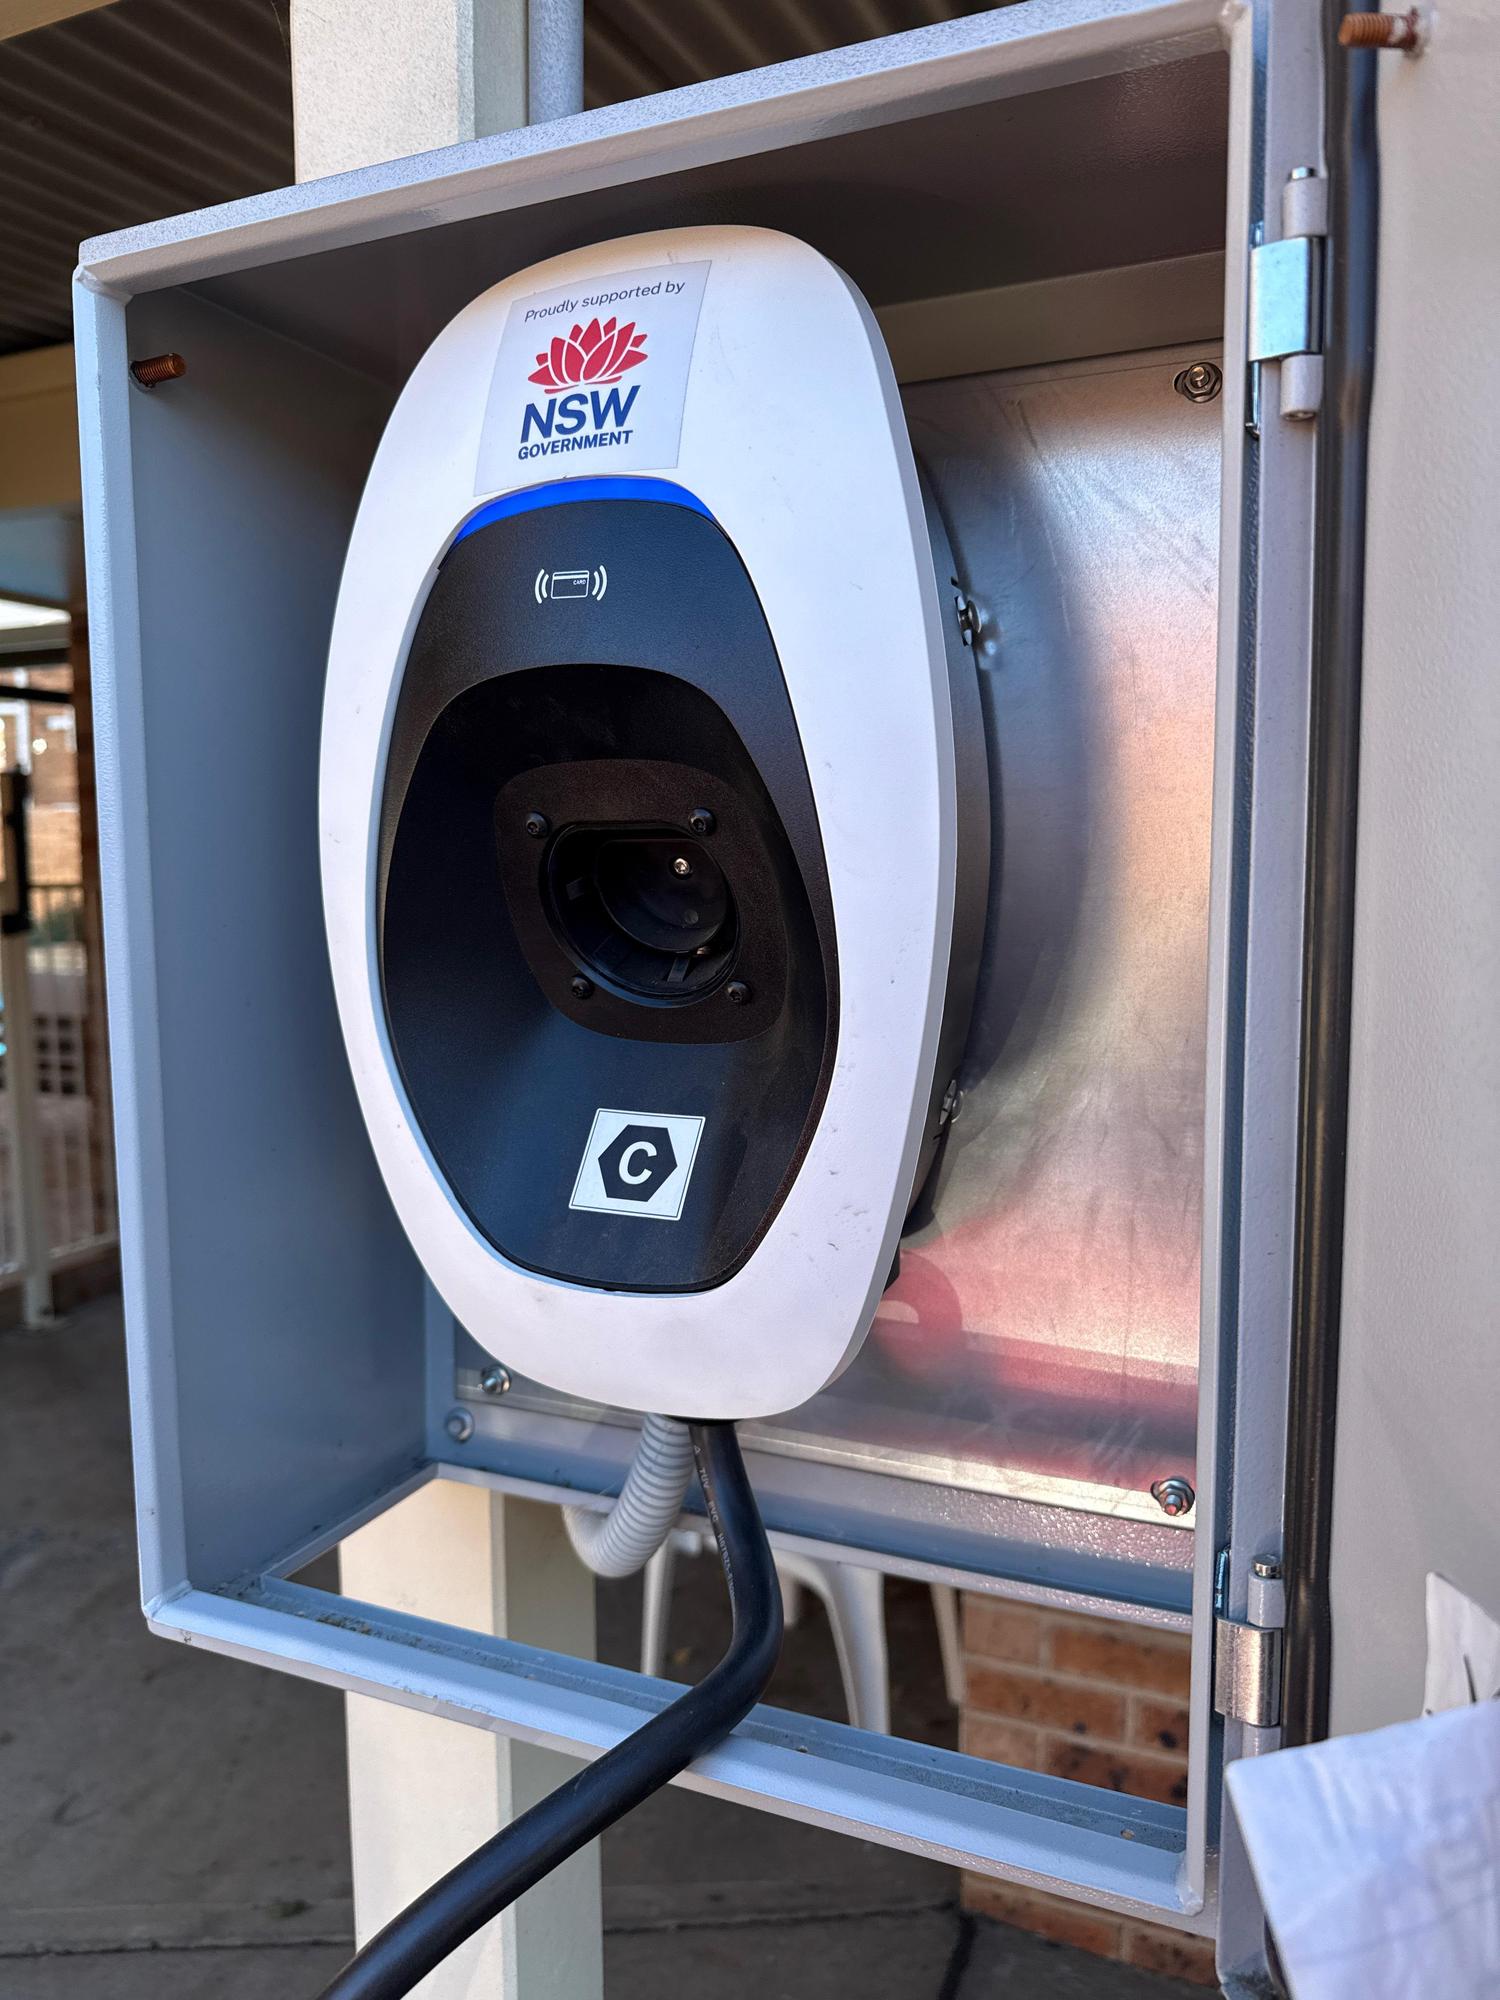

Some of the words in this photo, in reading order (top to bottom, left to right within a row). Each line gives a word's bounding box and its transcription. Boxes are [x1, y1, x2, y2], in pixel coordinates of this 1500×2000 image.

[524, 299, 578, 322] Proudly
[581, 282, 661, 307] supported
[665, 280, 686, 295] by
[520, 385, 641, 443] NSW
[518, 430, 634, 460] GOVERNMENT
[619, 1141, 657, 1184] C
[708, 1501, 719, 1521] PVC
